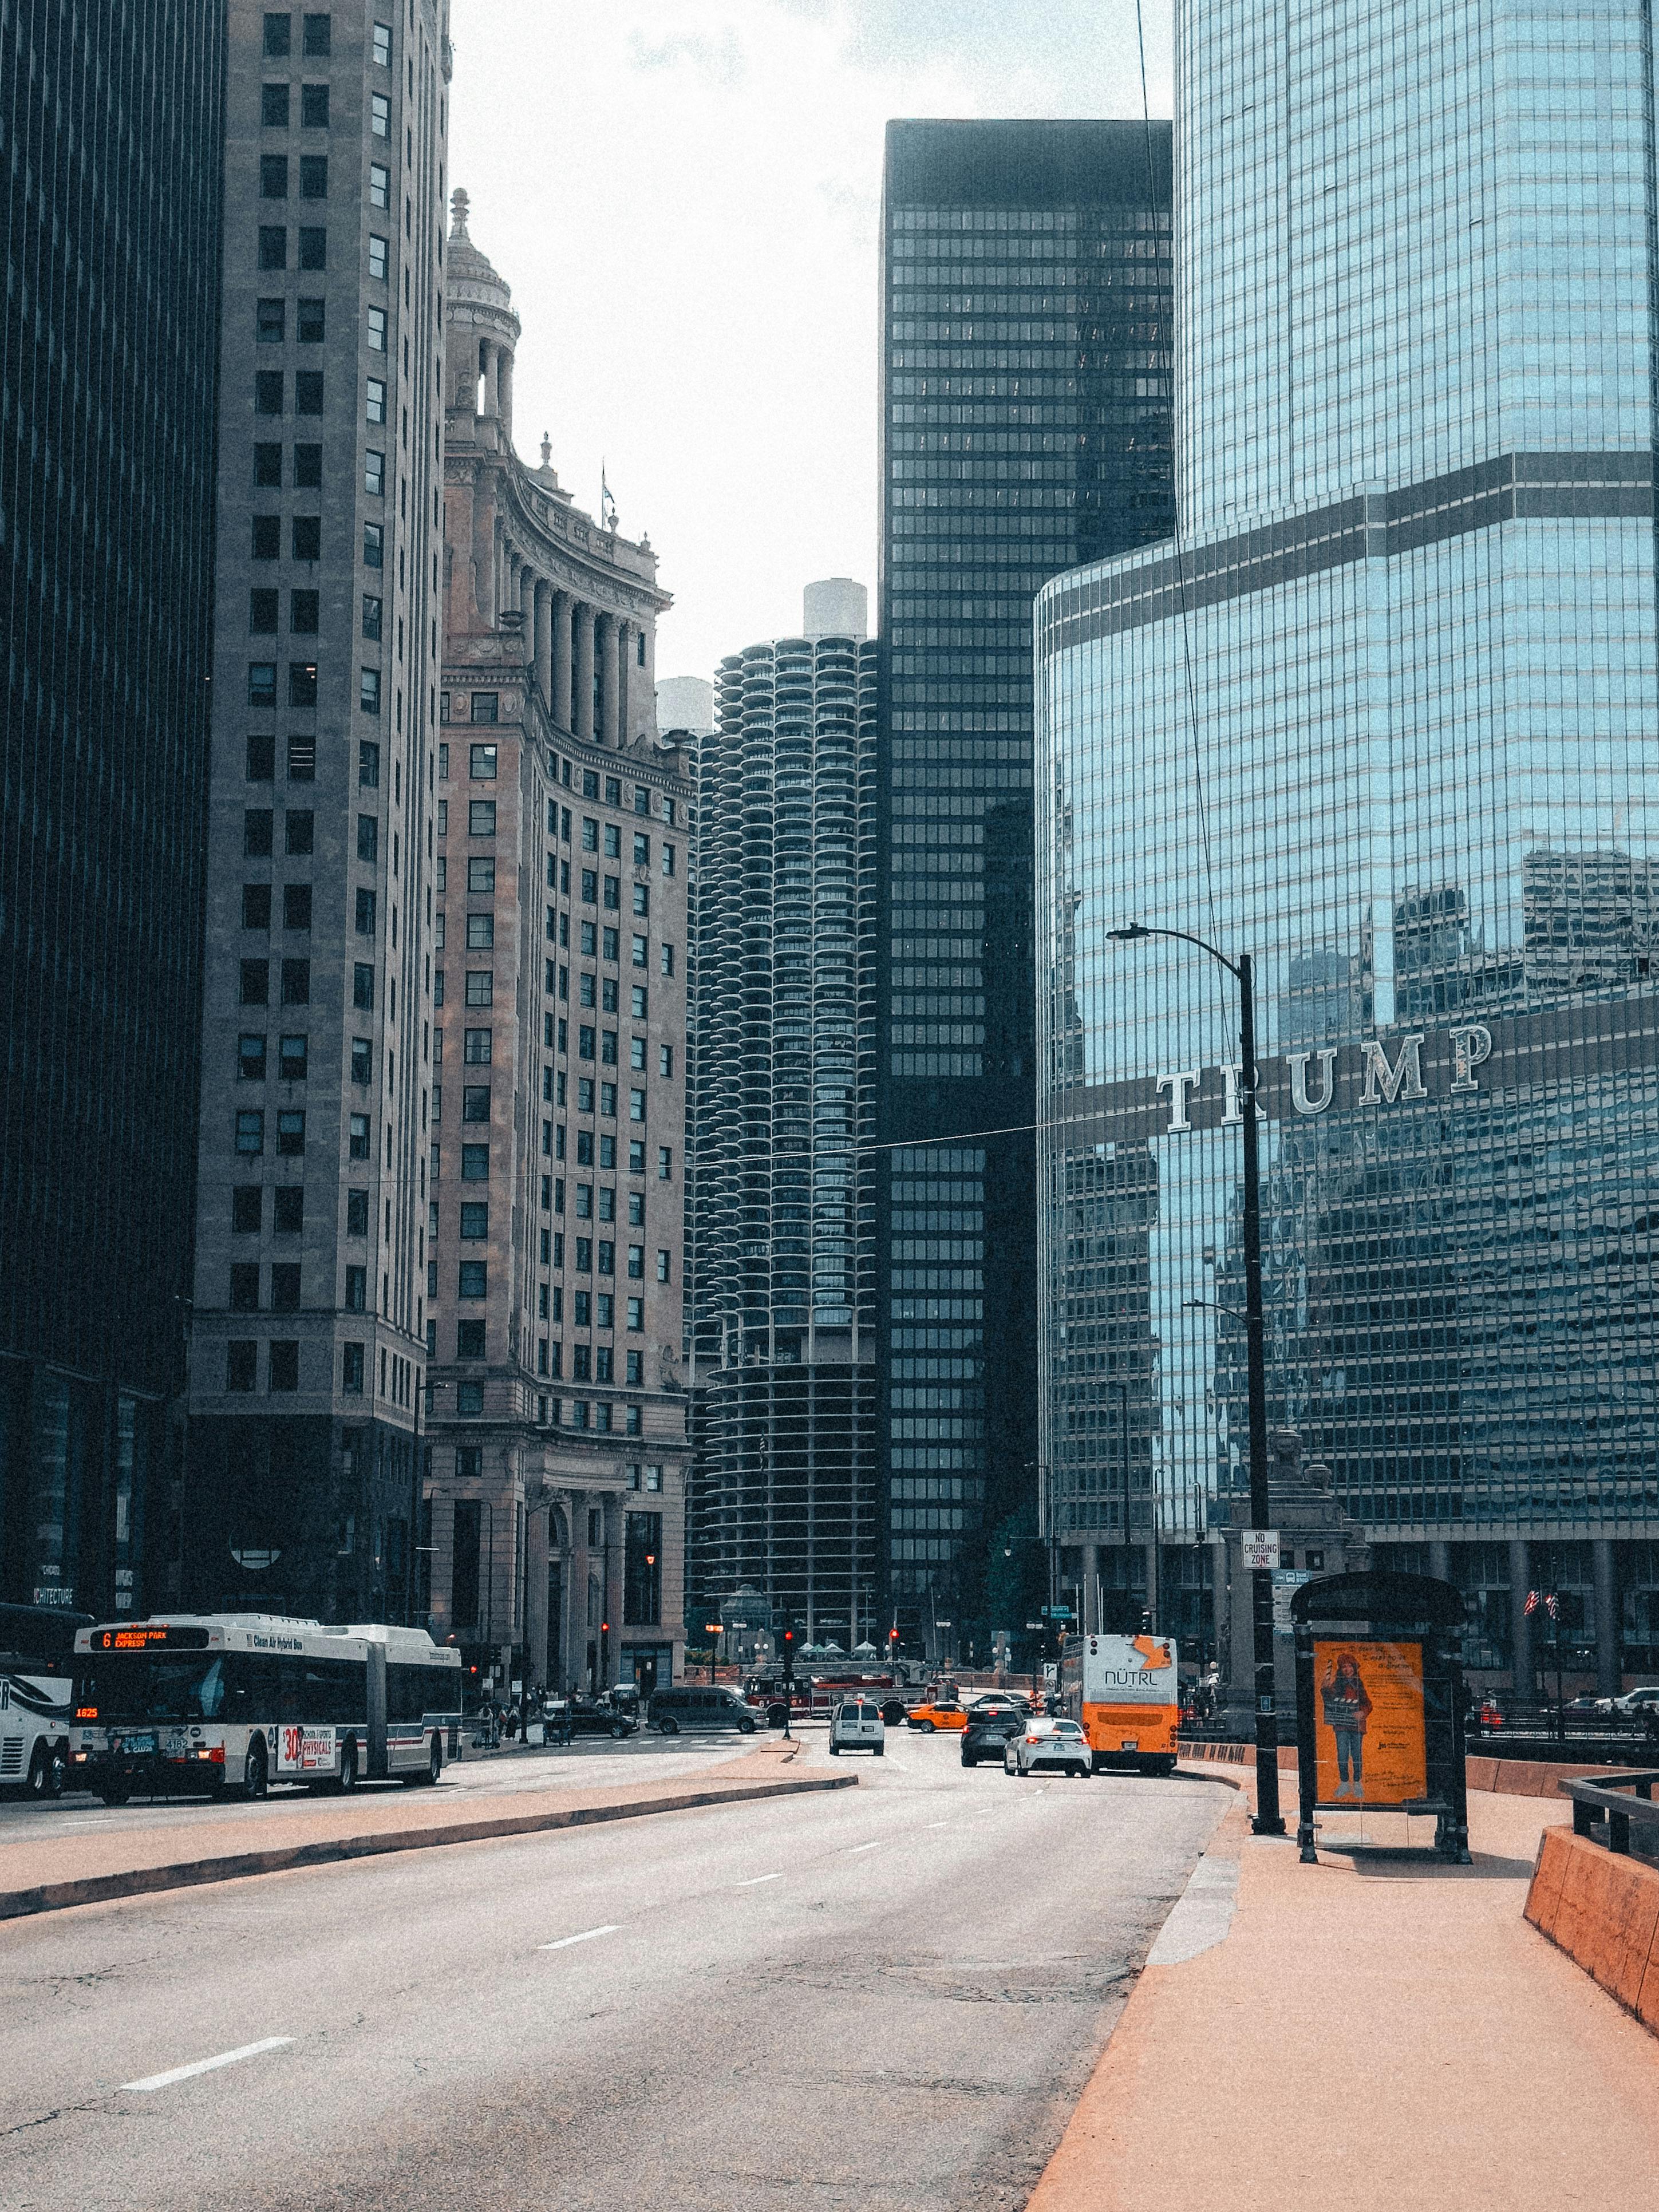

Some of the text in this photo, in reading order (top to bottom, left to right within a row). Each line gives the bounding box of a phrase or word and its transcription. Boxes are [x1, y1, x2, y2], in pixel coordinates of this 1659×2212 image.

[1156, 1025, 1491, 1133] TRUMP
[1255, 1533, 1265, 1543] NO
[1244, 1544, 1277, 1554] CRUISING
[1251, 1555, 1270, 1564] ZONE
[103, 1633, 111, 1648] 6
[254, 1634, 268, 1648] Clean
[277, 1637, 293, 1651] Hybrid
